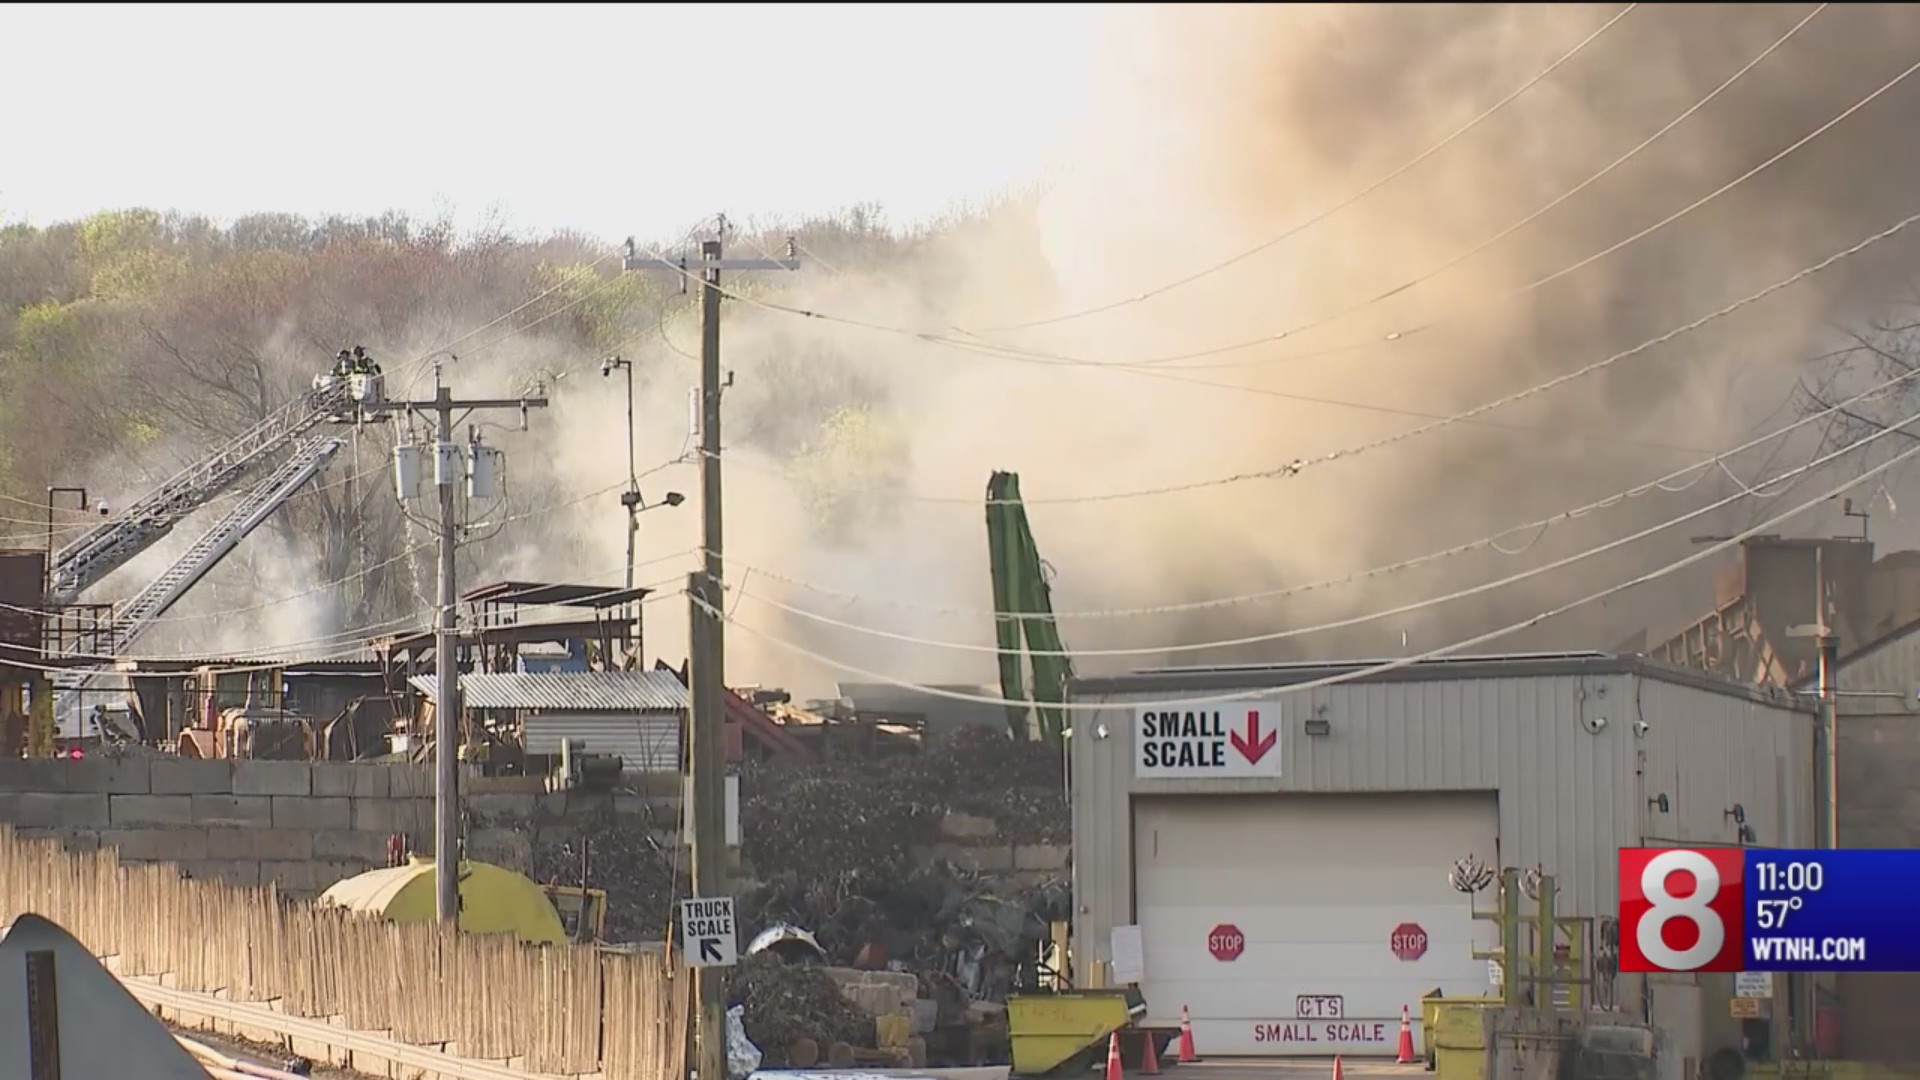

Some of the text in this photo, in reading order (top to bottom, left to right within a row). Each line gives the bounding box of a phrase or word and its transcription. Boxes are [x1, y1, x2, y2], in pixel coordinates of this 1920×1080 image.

[1142, 711, 1225, 738] SMALL
[1143, 741, 1225, 767] SCALE
[685, 900, 731, 918] TRUCK
[688, 919, 732, 937] SCALE
[1210, 934, 1243, 951] STOP
[1392, 933, 1426, 950] STOP
[1300, 998, 1340, 1016] CTS
[1254, 1023, 1385, 1042] SMALL SCALE
